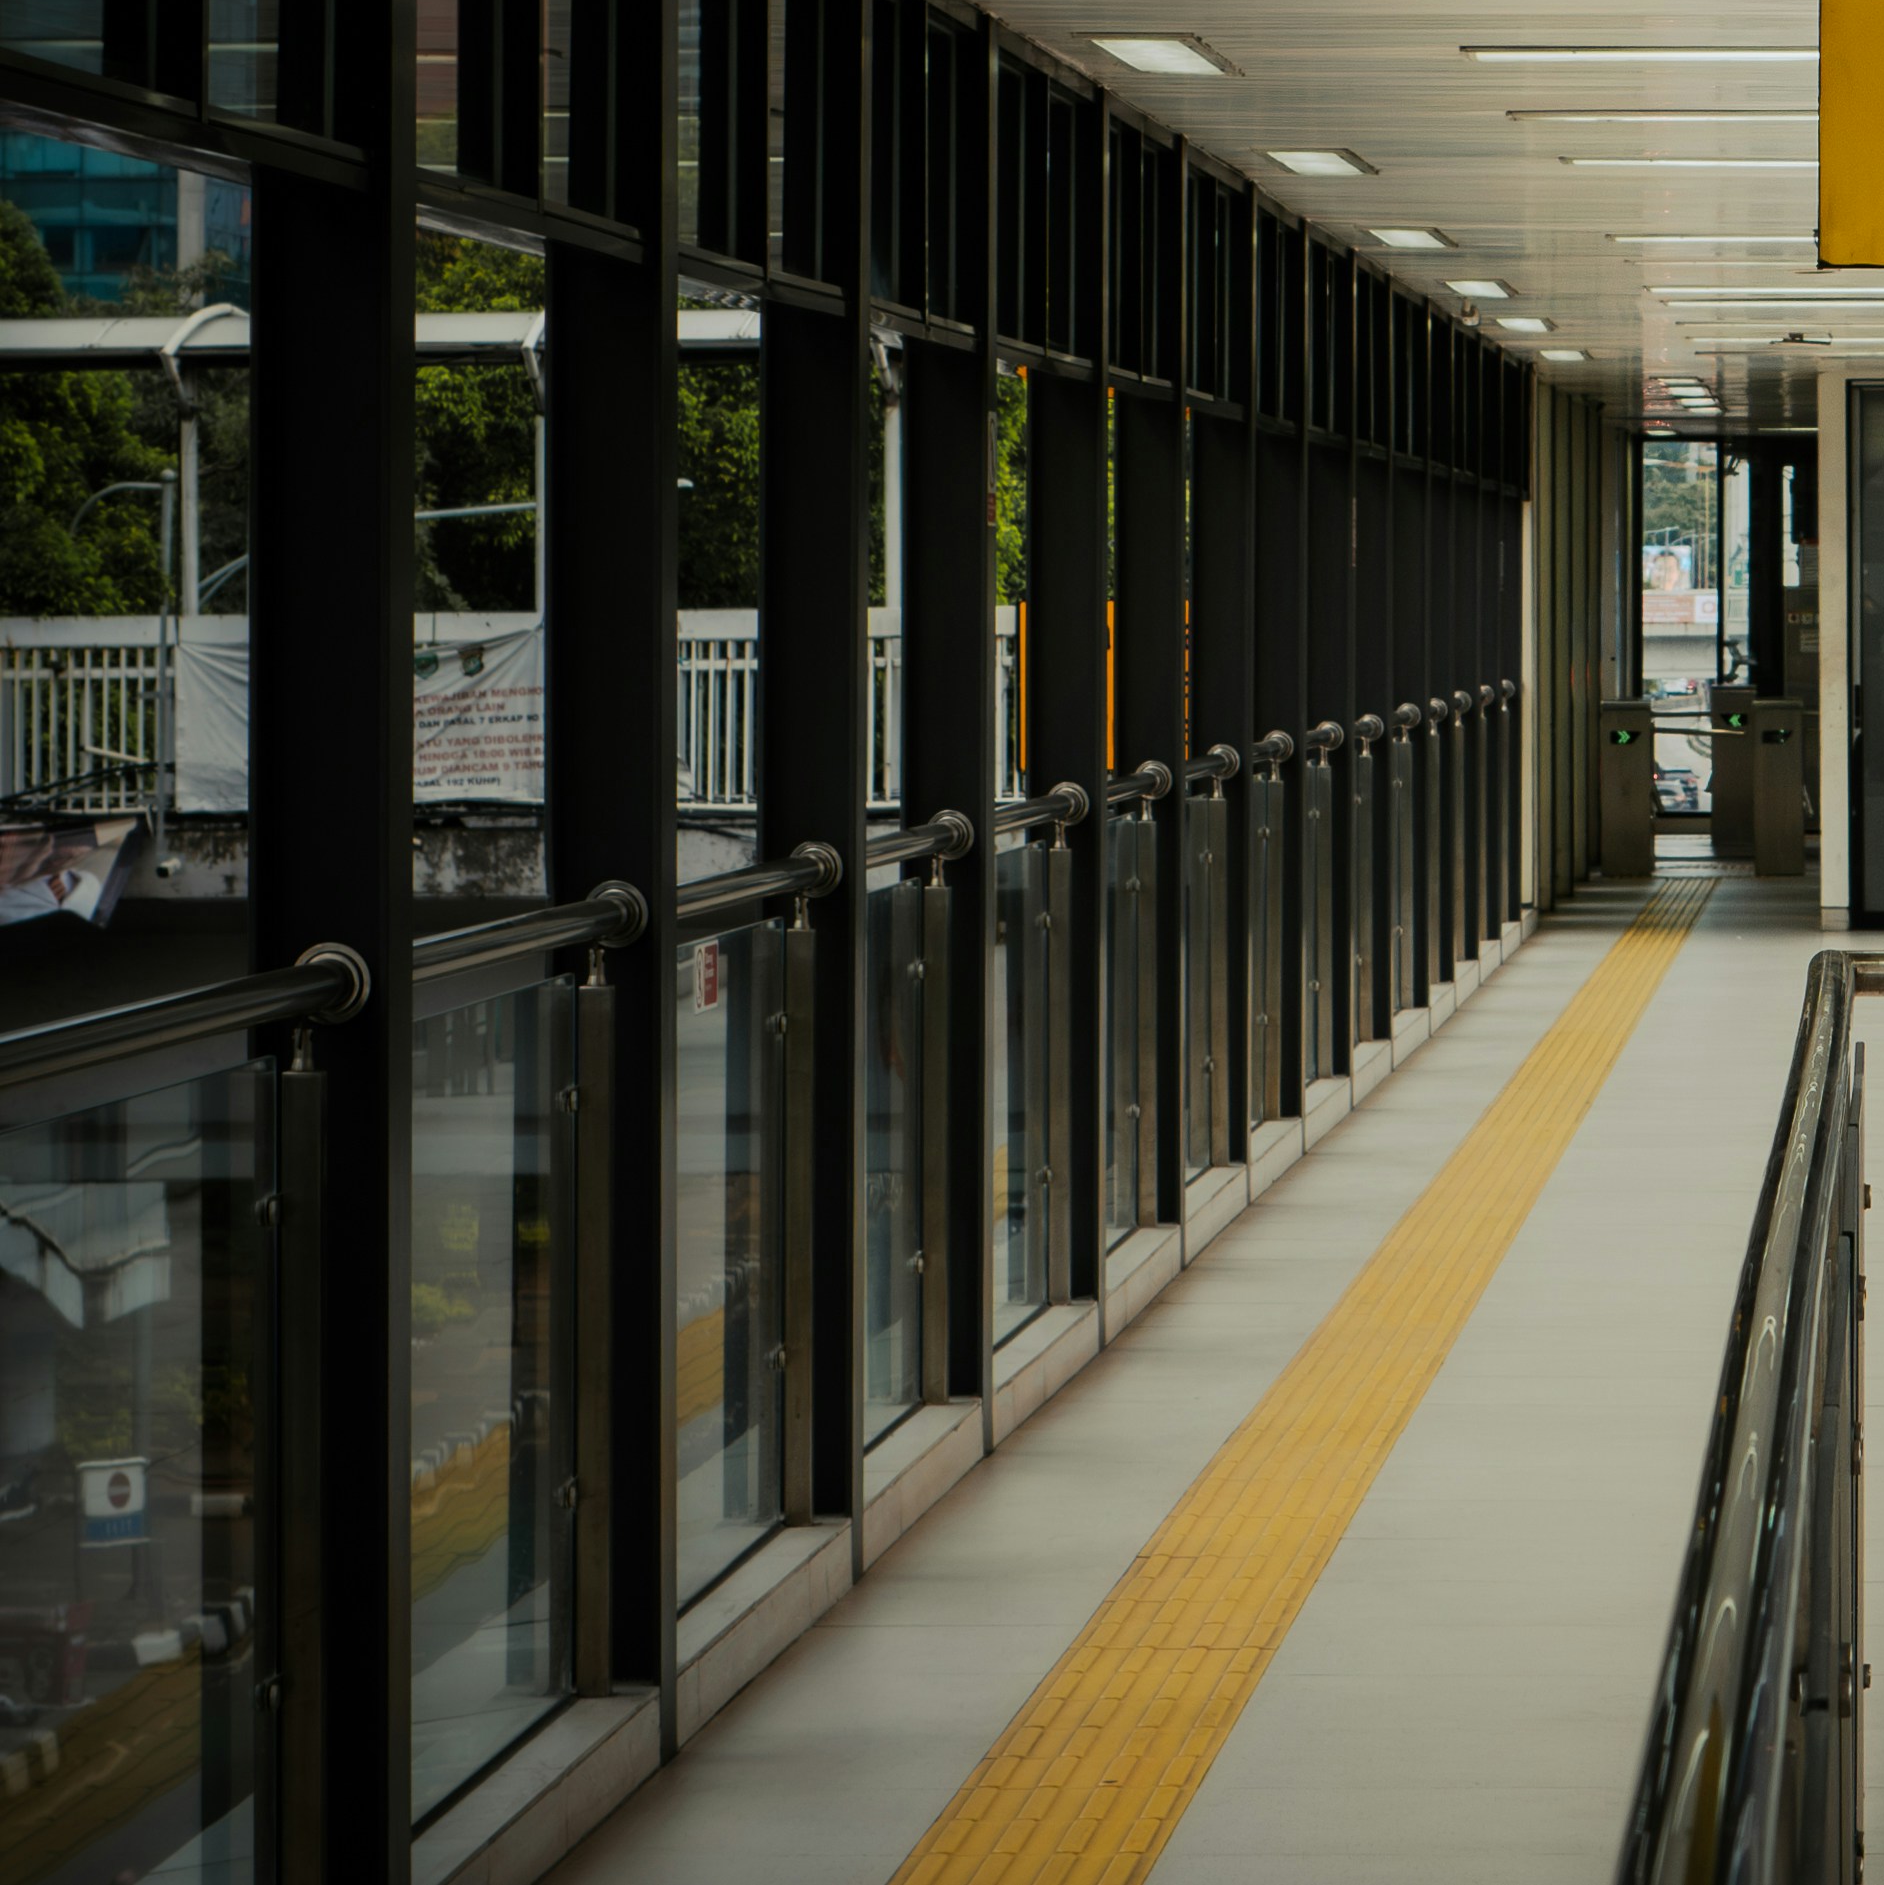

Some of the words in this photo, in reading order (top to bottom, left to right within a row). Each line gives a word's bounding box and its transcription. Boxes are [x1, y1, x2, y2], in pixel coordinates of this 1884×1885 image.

[491, 686, 542, 698] MENGHO
[476, 702, 505, 712] LAIN
[484, 733, 543, 745] DIBOLEHK
